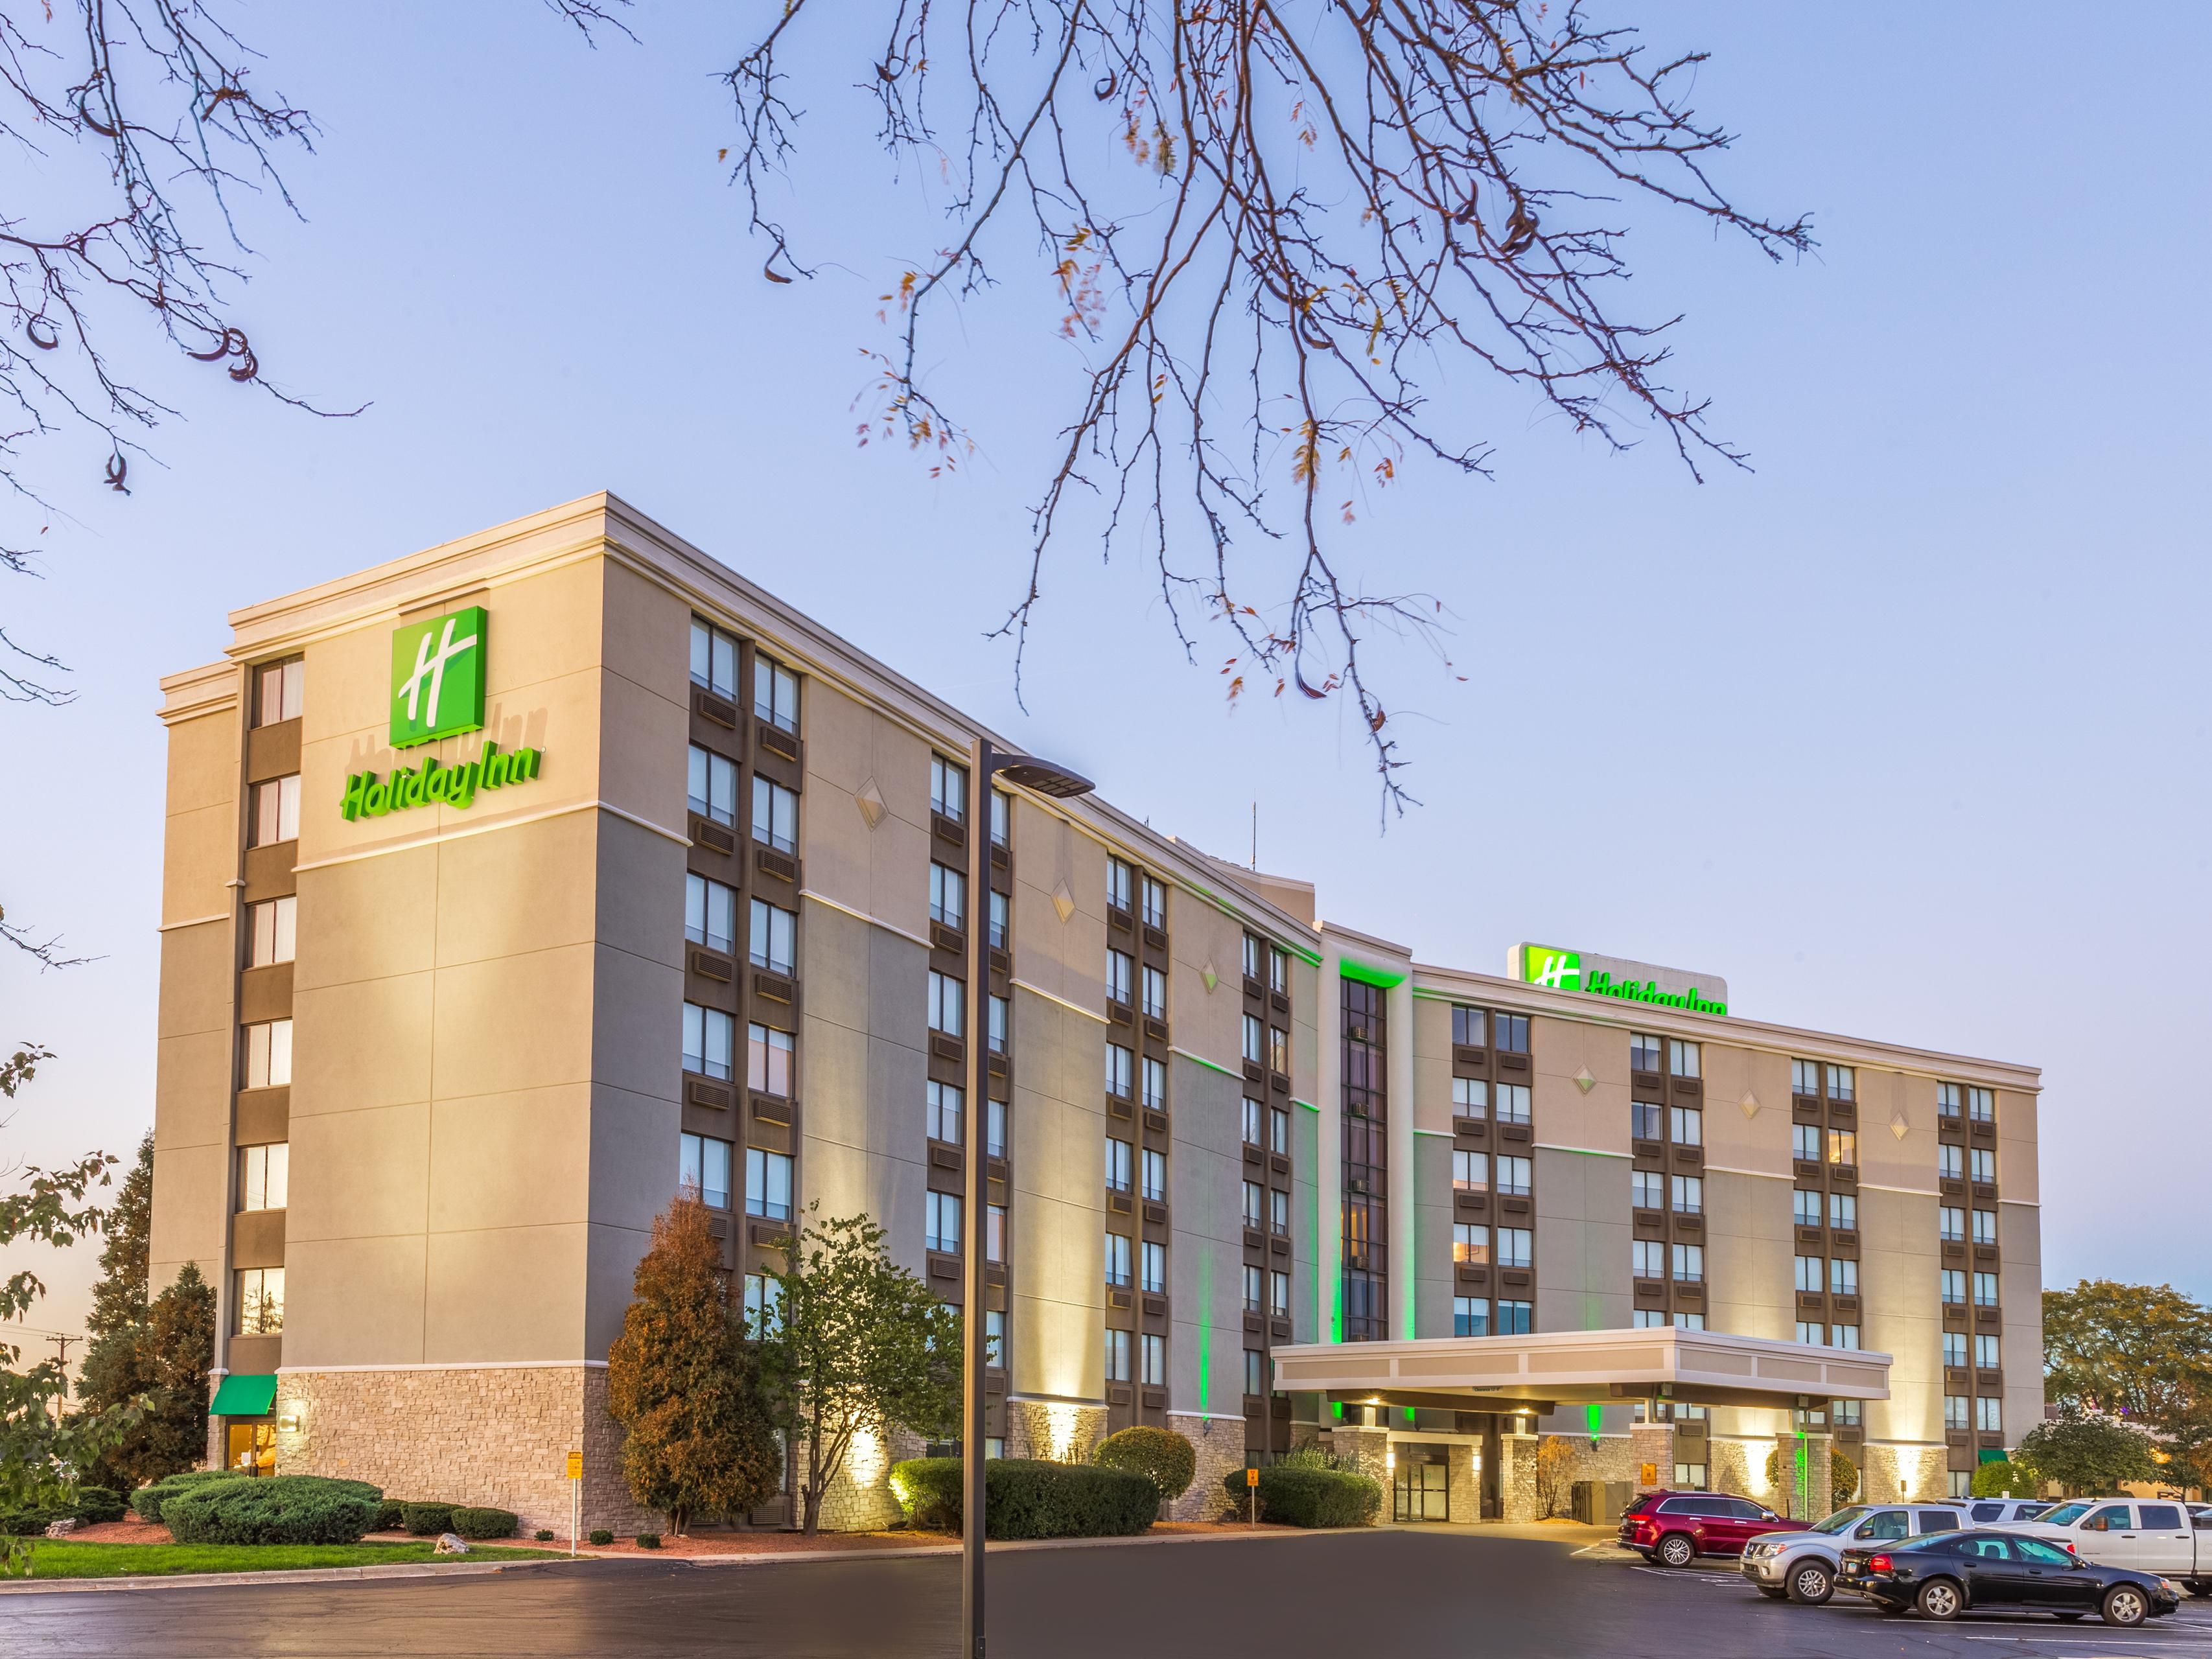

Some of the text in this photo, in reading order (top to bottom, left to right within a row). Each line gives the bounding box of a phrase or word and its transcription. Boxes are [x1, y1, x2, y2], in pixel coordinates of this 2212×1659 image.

[340, 739, 541, 823] Holiday Inn
[1686, 987, 1727, 1016] Inn
